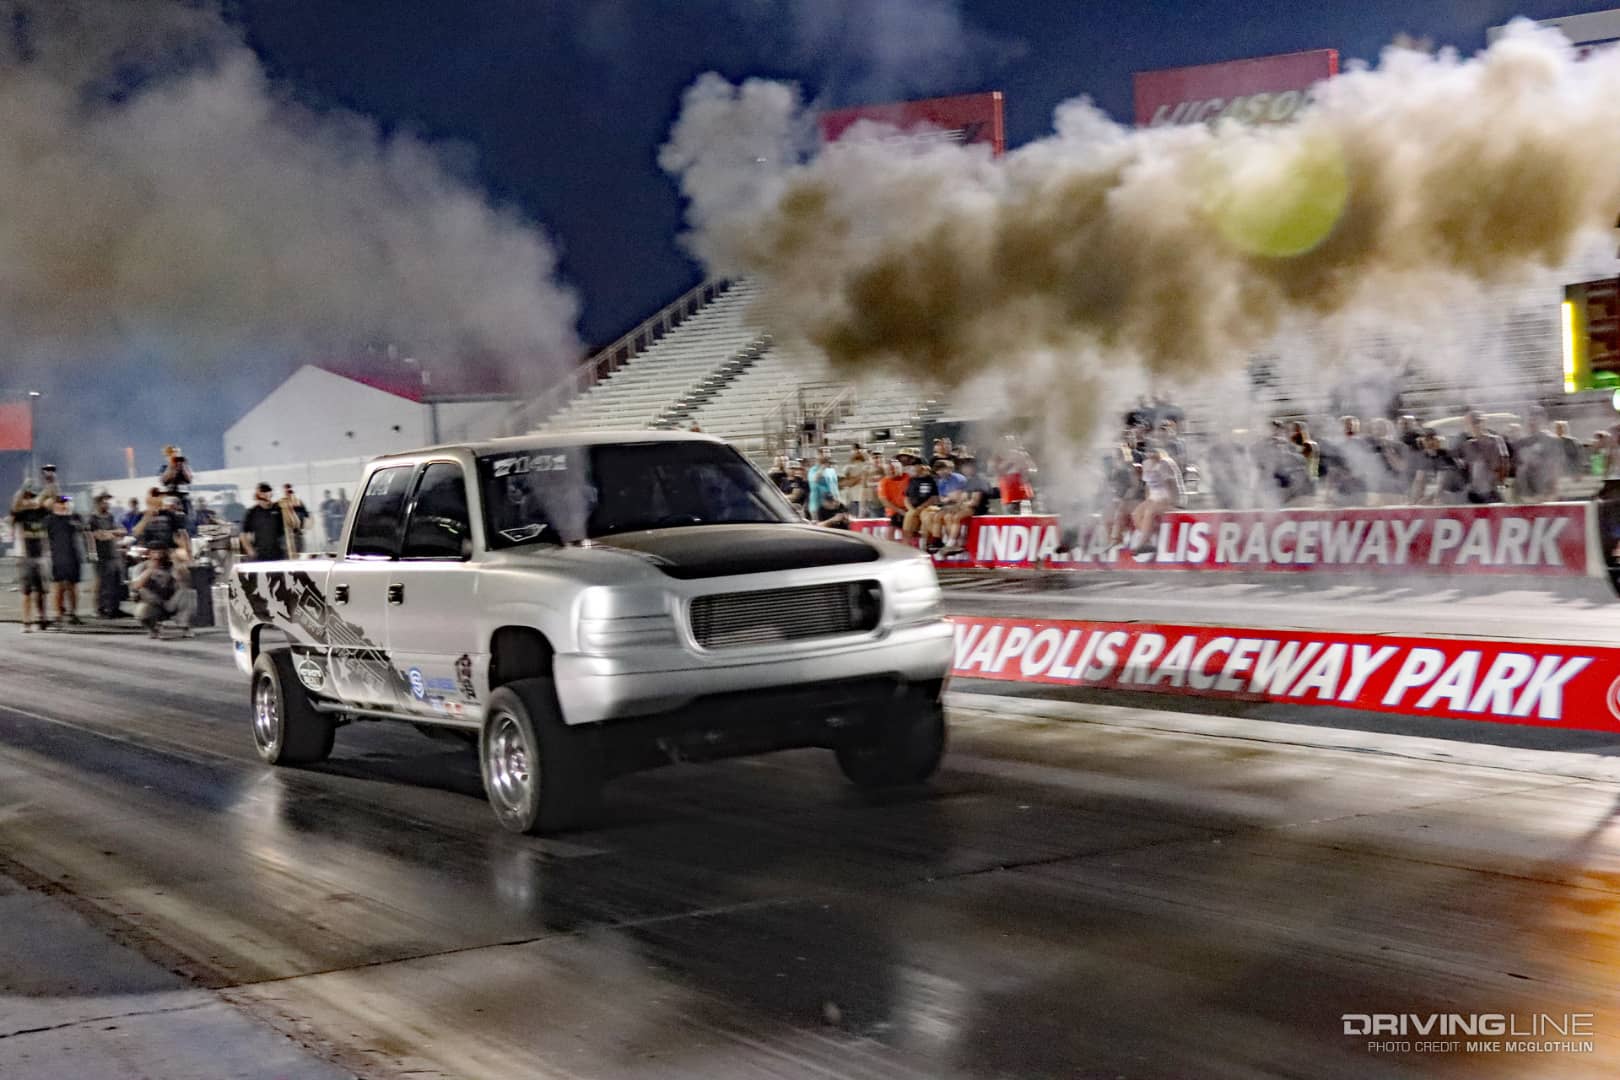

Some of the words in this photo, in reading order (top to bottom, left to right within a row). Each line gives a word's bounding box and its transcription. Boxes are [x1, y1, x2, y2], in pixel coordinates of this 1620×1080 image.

[1215, 519, 1425, 564] RACEWAY
[1428, 517, 1567, 566] PARK
[1118, 632, 1400, 701] RACEWAY
[1381, 647, 1594, 719] PARK
